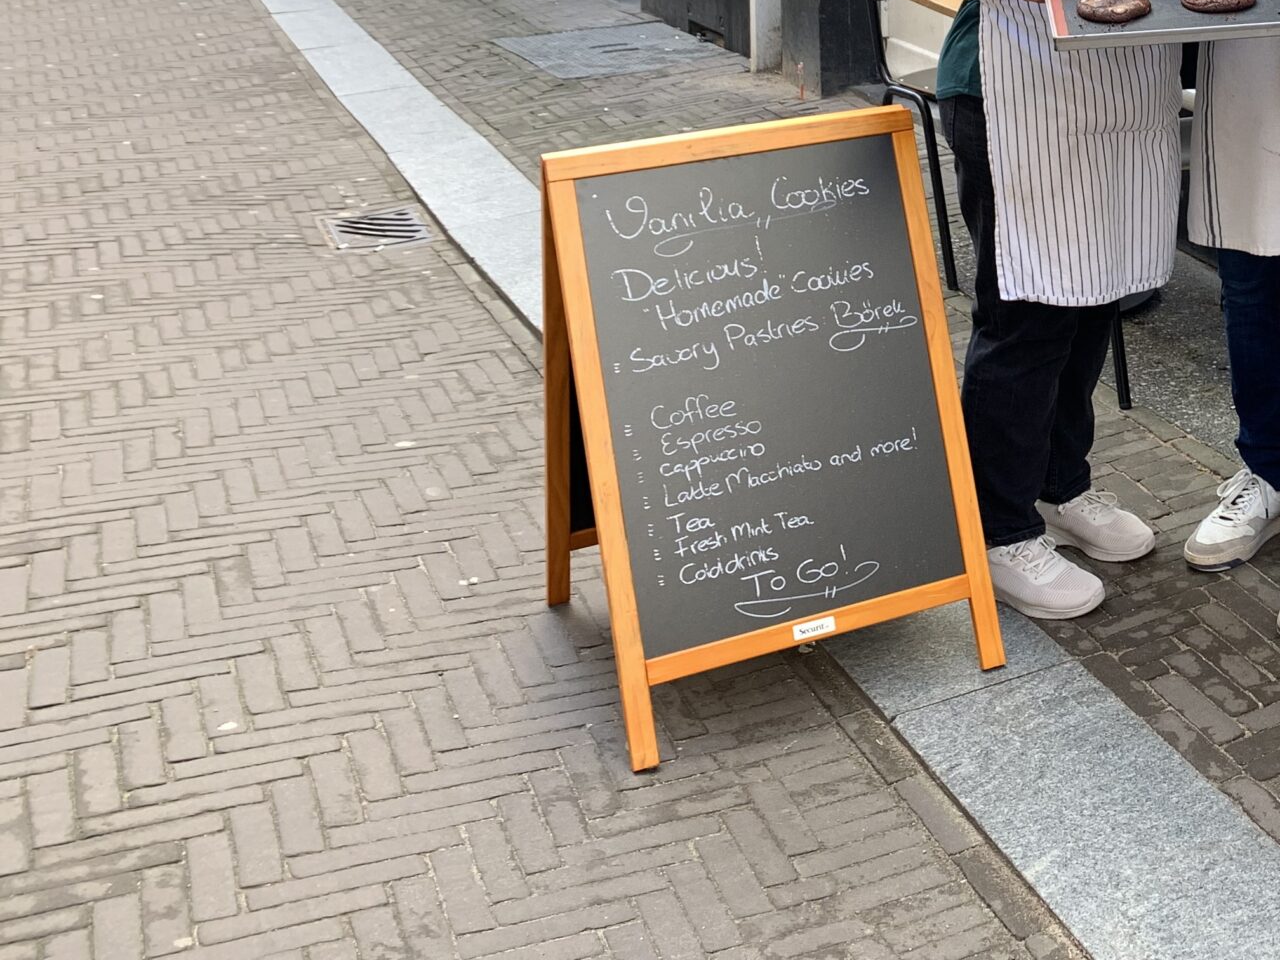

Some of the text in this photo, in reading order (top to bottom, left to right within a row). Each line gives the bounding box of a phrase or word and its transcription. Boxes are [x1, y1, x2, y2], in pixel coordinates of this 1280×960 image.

[605, 175, 870, 239] Vanilia Cookies
[629, 342, 720, 371] Savory
[830, 298, 906, 328] Börek
[651, 394, 737, 429] Coffee
[661, 421, 762, 456] Espresso
[725, 454, 823, 494] Macchiato
[829, 444, 862, 467] and
[870, 426, 919, 458] more!
[666, 512, 716, 534] Tea
[731, 518, 773, 542] Mint
[774, 511, 815, 530] Tea
